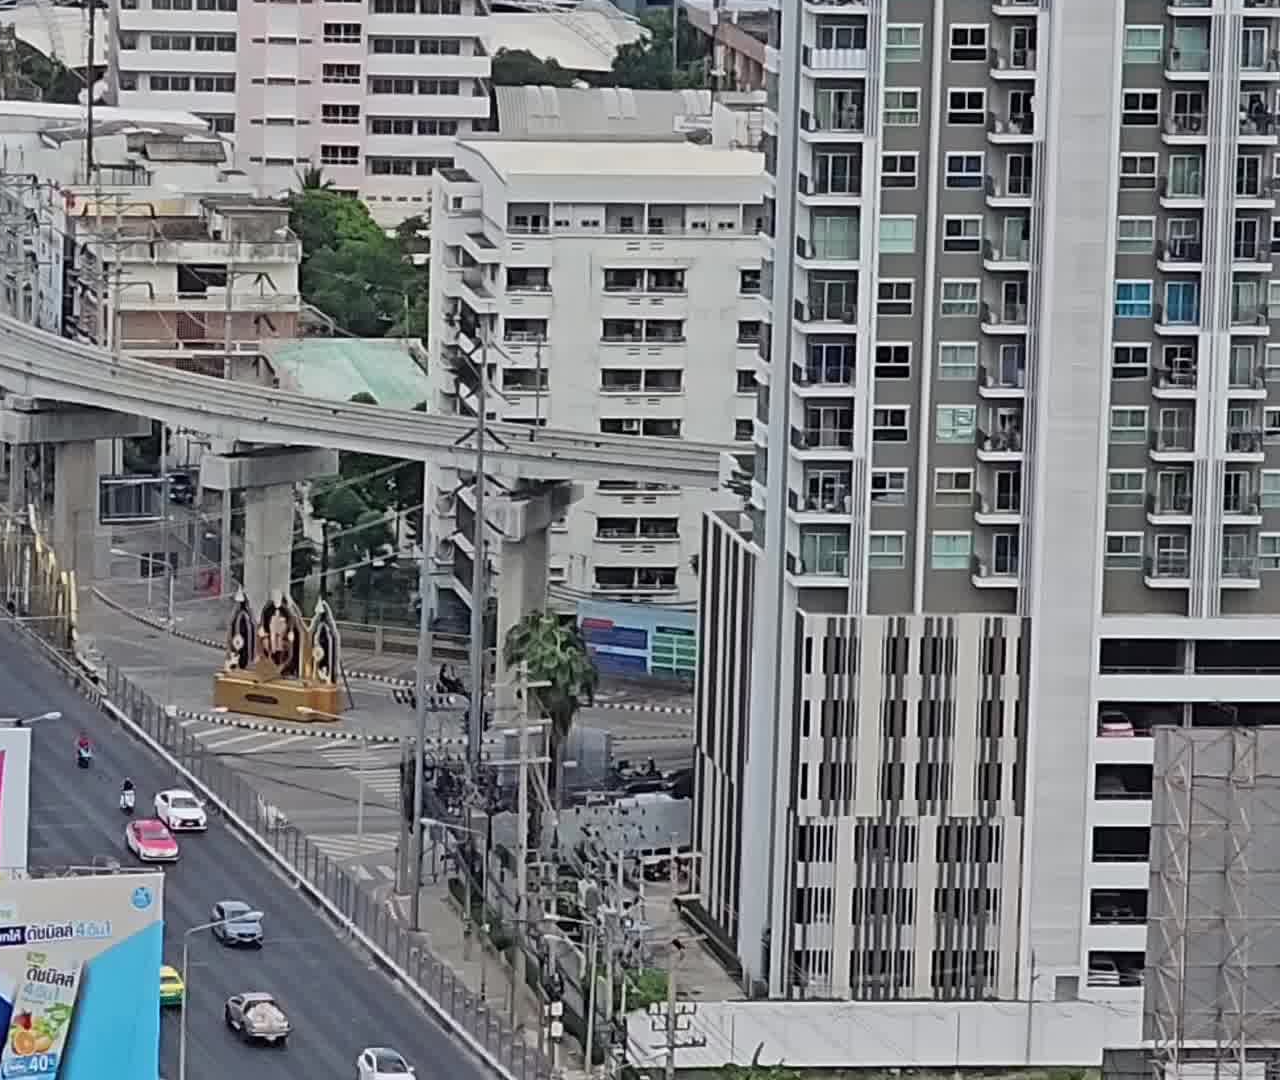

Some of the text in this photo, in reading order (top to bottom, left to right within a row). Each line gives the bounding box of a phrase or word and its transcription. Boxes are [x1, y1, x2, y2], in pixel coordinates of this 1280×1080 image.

[26, 924, 74, 941] ดัชมิลล์
[26, 966, 75, 988] ดัชมิลล์
